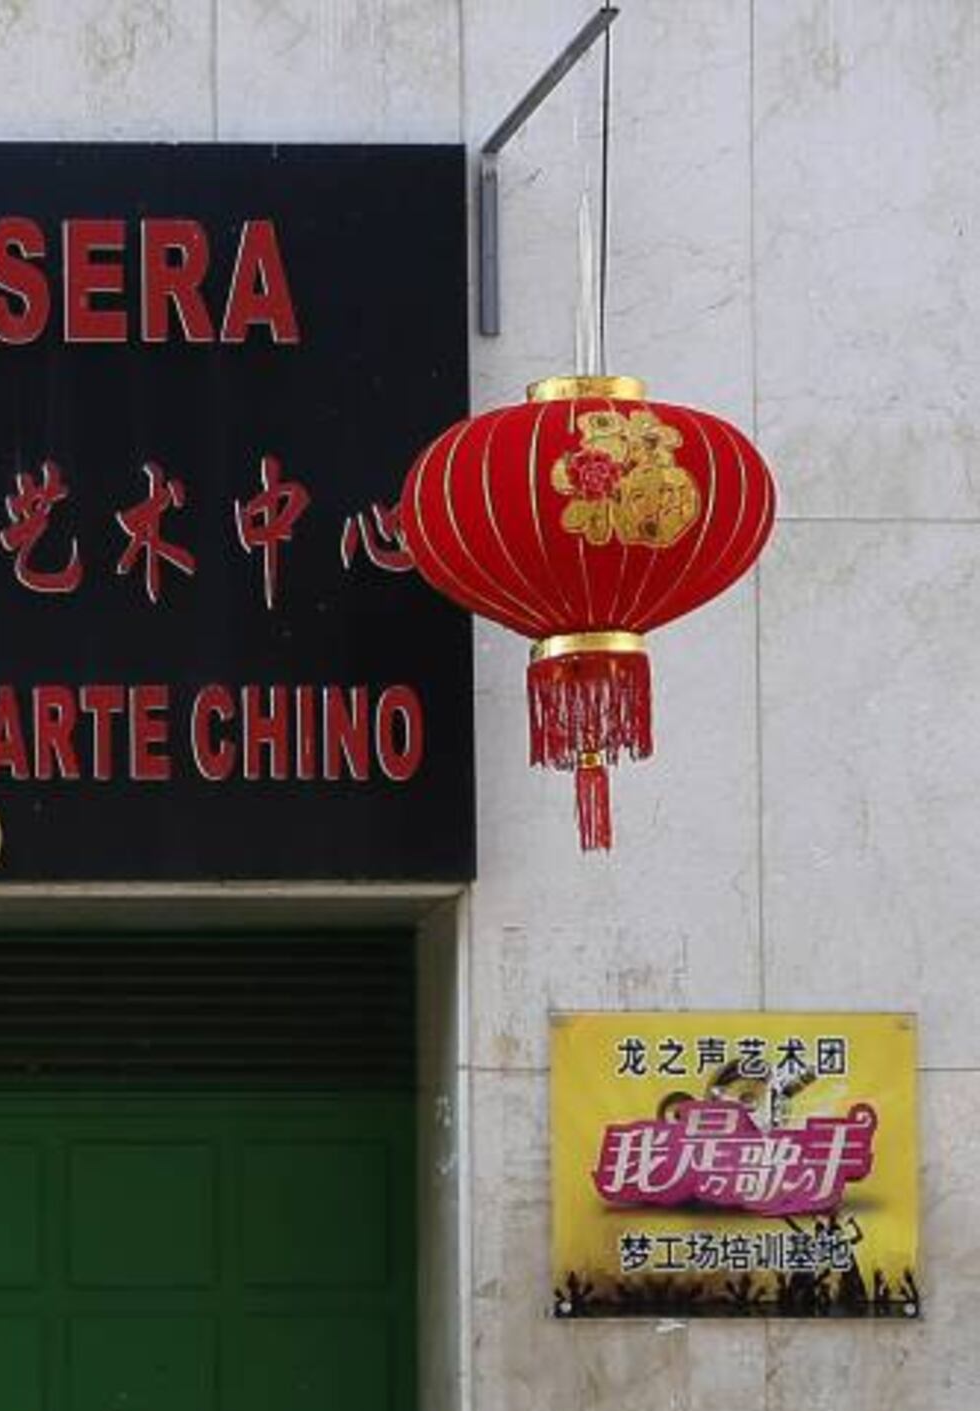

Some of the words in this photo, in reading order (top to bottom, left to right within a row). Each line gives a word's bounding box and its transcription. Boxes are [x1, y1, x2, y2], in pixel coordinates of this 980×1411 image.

[190, 684, 422, 782] CHINO
[617, 1036, 847, 1079] 龙之声艺术团
[603, 1106, 873, 1201] 我是歌手
[620, 1233, 851, 1272] 梦工场培训基地
